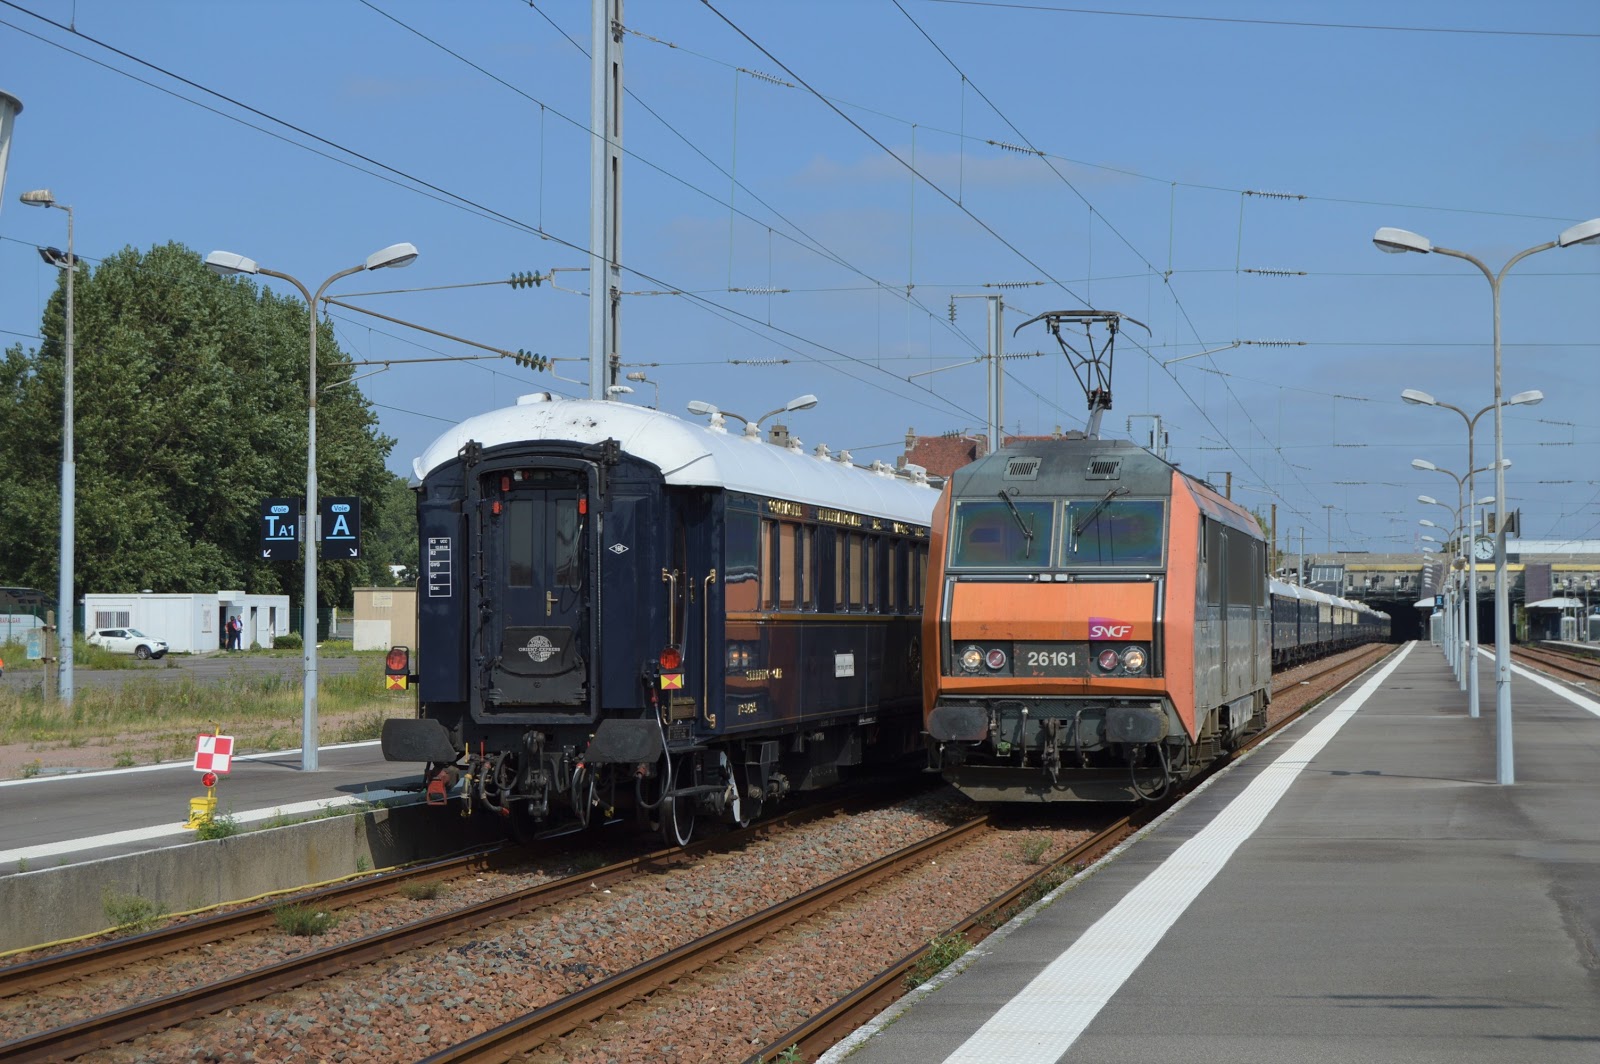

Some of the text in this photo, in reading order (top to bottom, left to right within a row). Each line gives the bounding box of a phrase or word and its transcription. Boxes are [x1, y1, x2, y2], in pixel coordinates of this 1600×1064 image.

[332, 515, 350, 535] A
[1090, 625, 1131, 638] SNCF
[1027, 651, 1076, 666] 26161
